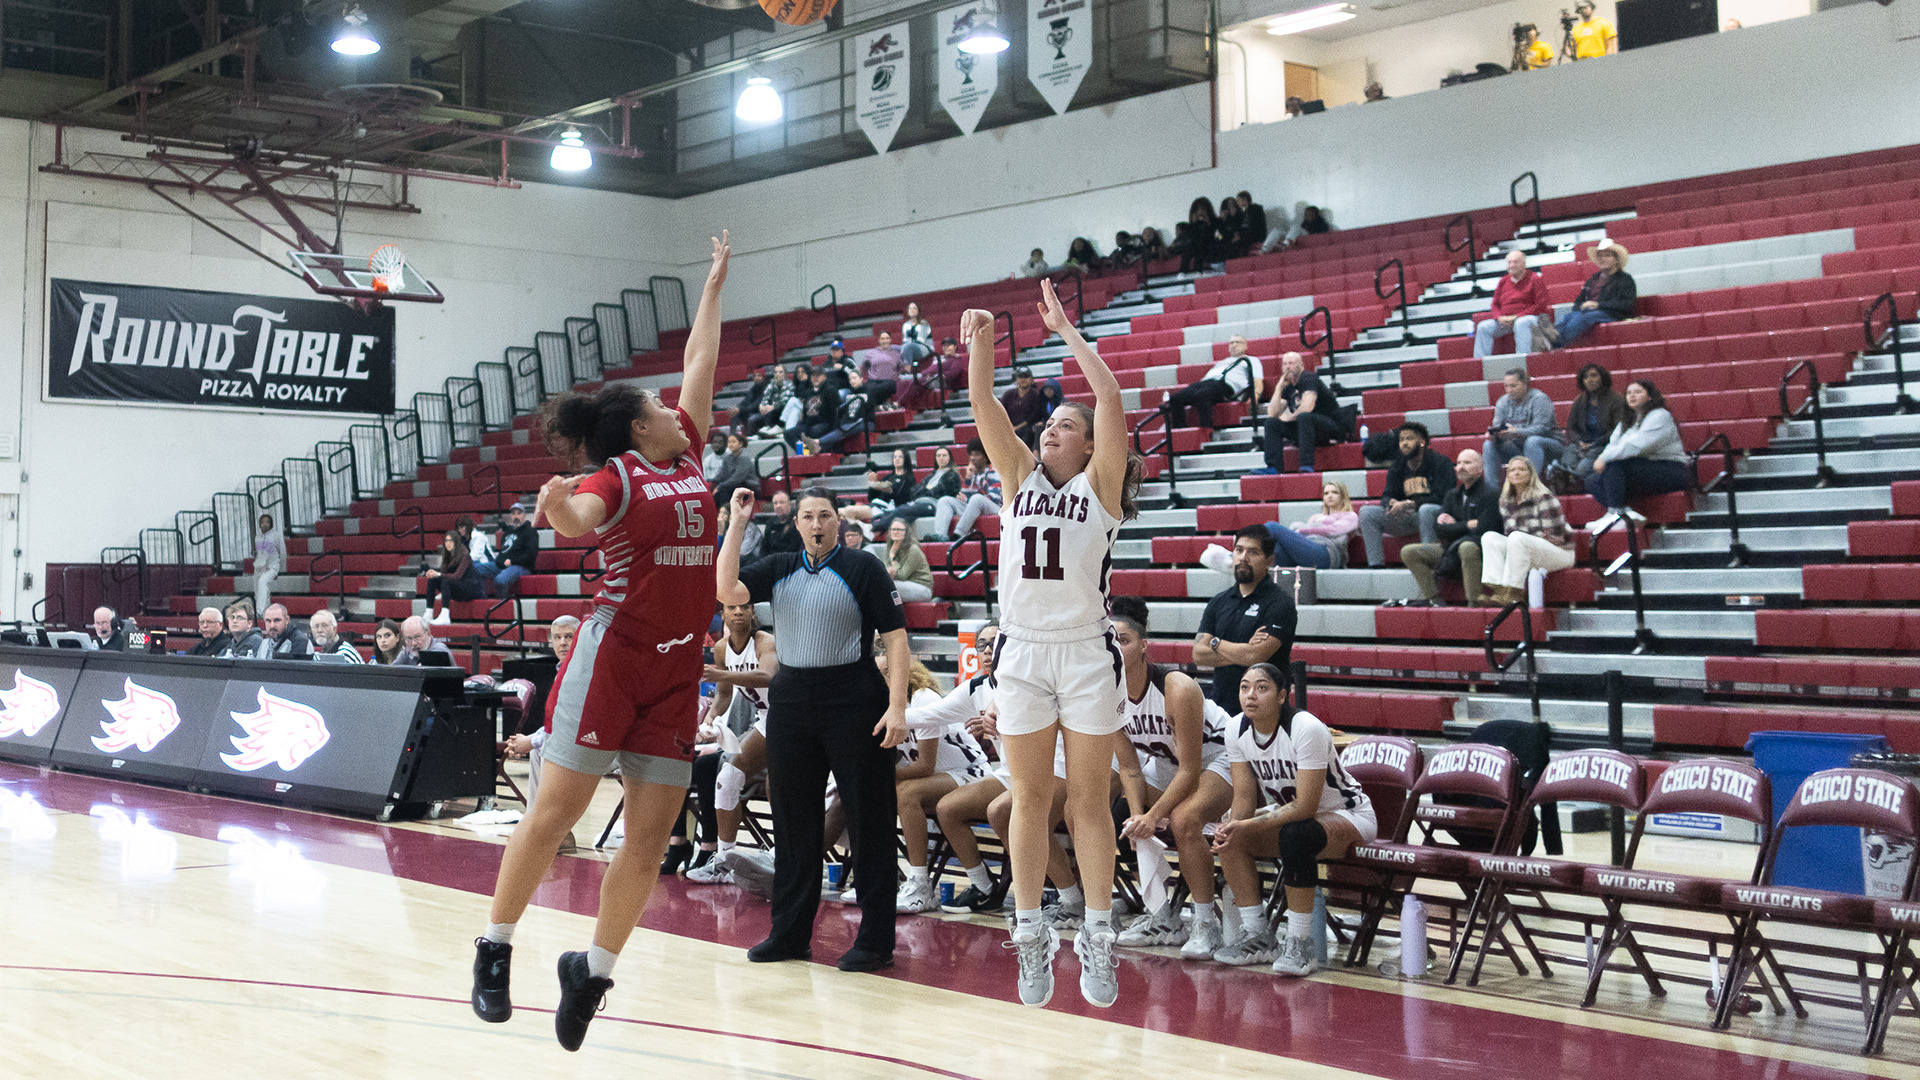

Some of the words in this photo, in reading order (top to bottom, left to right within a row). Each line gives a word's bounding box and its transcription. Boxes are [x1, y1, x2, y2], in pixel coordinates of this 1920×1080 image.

[68, 290, 248, 376] ROUND
[232, 304, 374, 385] TABLE
[200, 378, 253, 398] PIZZA
[263, 382, 348, 403] ROYALTY
[674, 499, 704, 538] 15
[1021, 526, 1064, 580] 11
[129, 632, 145, 645] POSS
[1122, 714, 1172, 735] ILDCATS
[1340, 742, 1376, 768] CHICO
[1376, 742, 1411, 772] STATE
[1428, 750, 1469, 776] CHICO
[1468, 750, 1506, 782] STATE
[1545, 755, 1591, 784] CHICO
[1590, 756, 1633, 790] STATE
[1661, 766, 1709, 794] CHICO
[1711, 766, 1758, 803] STATE
[1801, 775, 1853, 806] CHICO
[1853, 776, 1905, 815] STATE
[1416, 806, 1456, 819] ILDCATS
[1355, 847, 1416, 864] WILDCATS
[1479, 859, 1551, 877] WILDCATS
[1597, 873, 1676, 895] WILDCATS
[1736, 889, 1823, 912] WILDCATS
